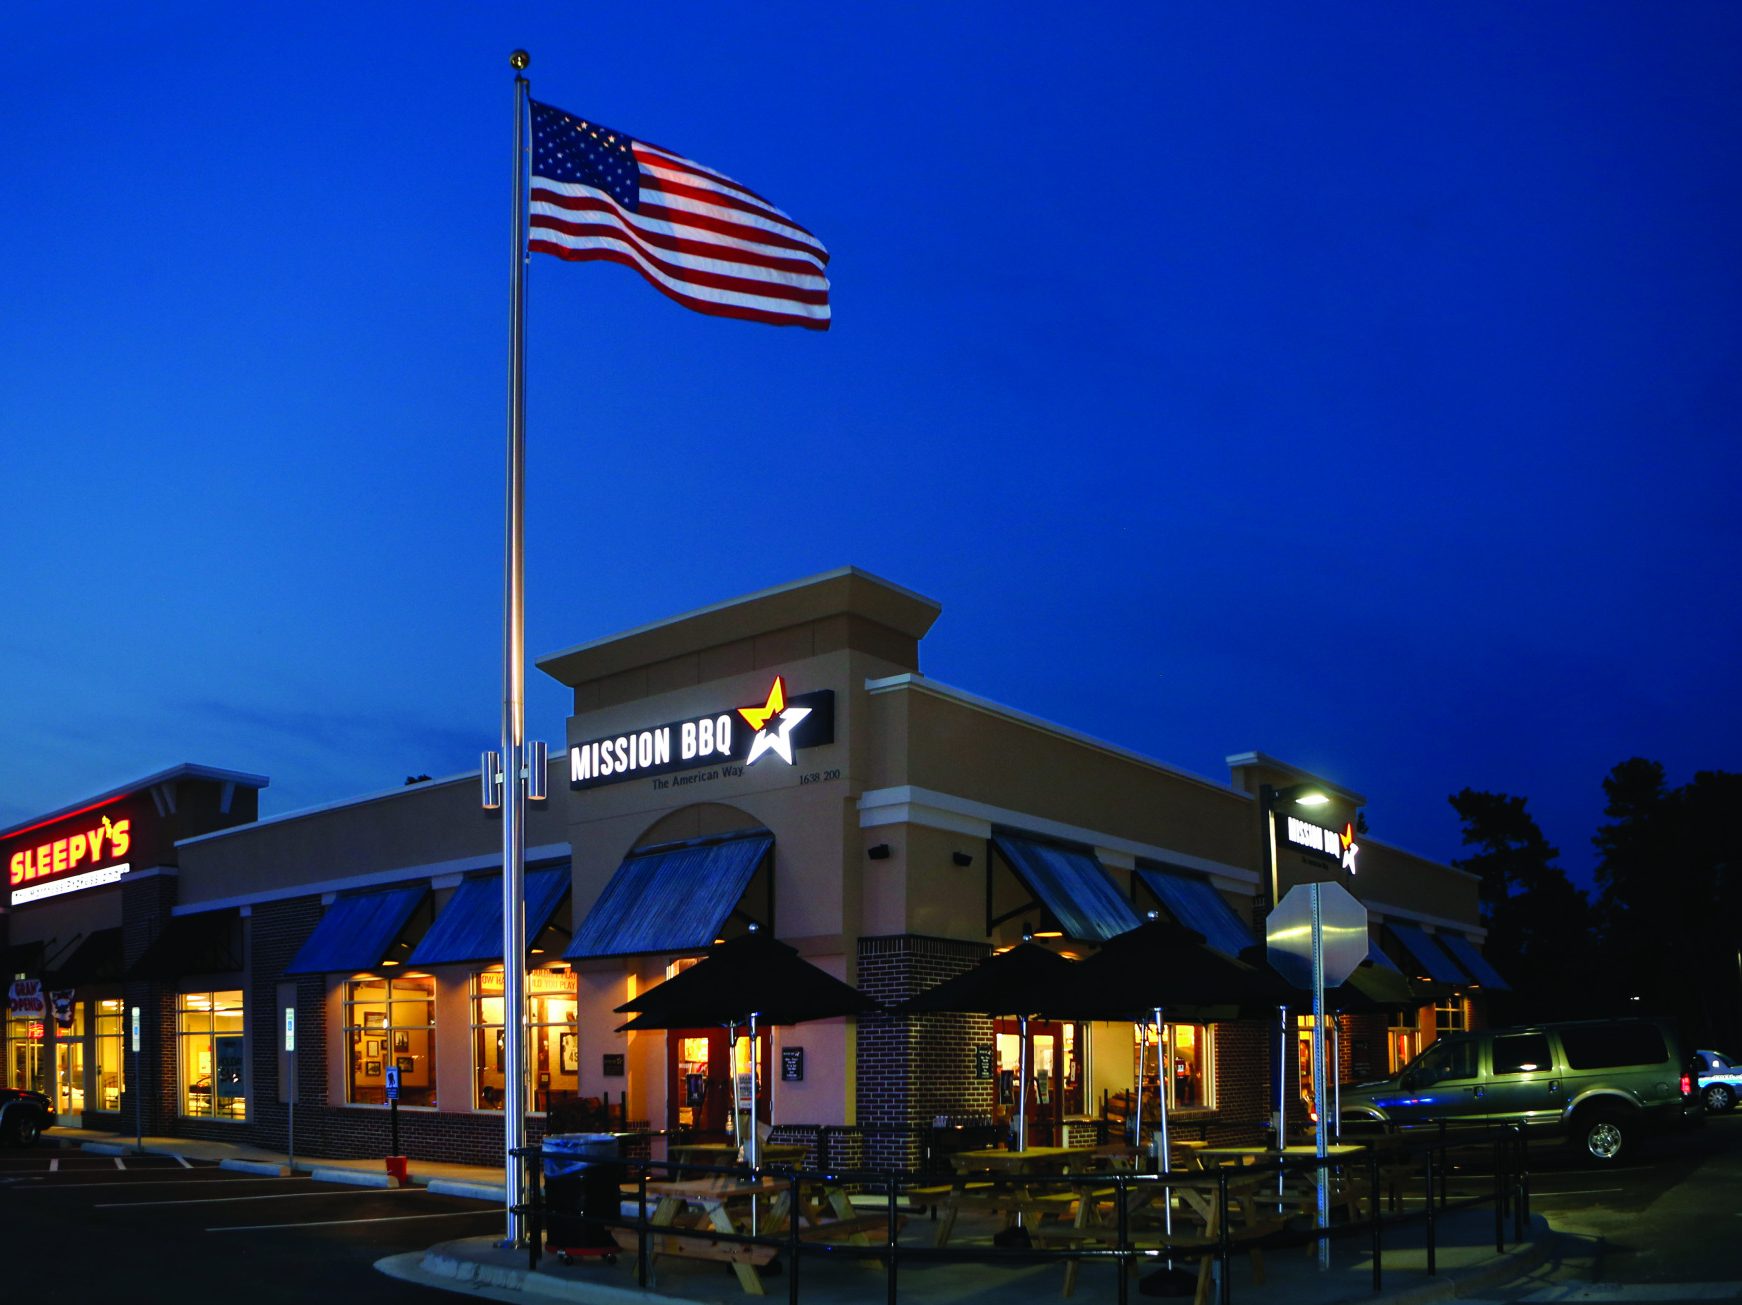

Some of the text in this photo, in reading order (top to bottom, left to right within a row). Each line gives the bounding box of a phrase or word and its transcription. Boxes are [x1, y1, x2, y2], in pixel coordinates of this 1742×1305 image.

[570, 714, 732, 783] MISSION BBQ
[652, 778, 670, 790] The
[672, 771, 719, 788] American
[800, 768, 841, 785] 1638 200
[10, 815, 130, 885] SLEEPY'S
